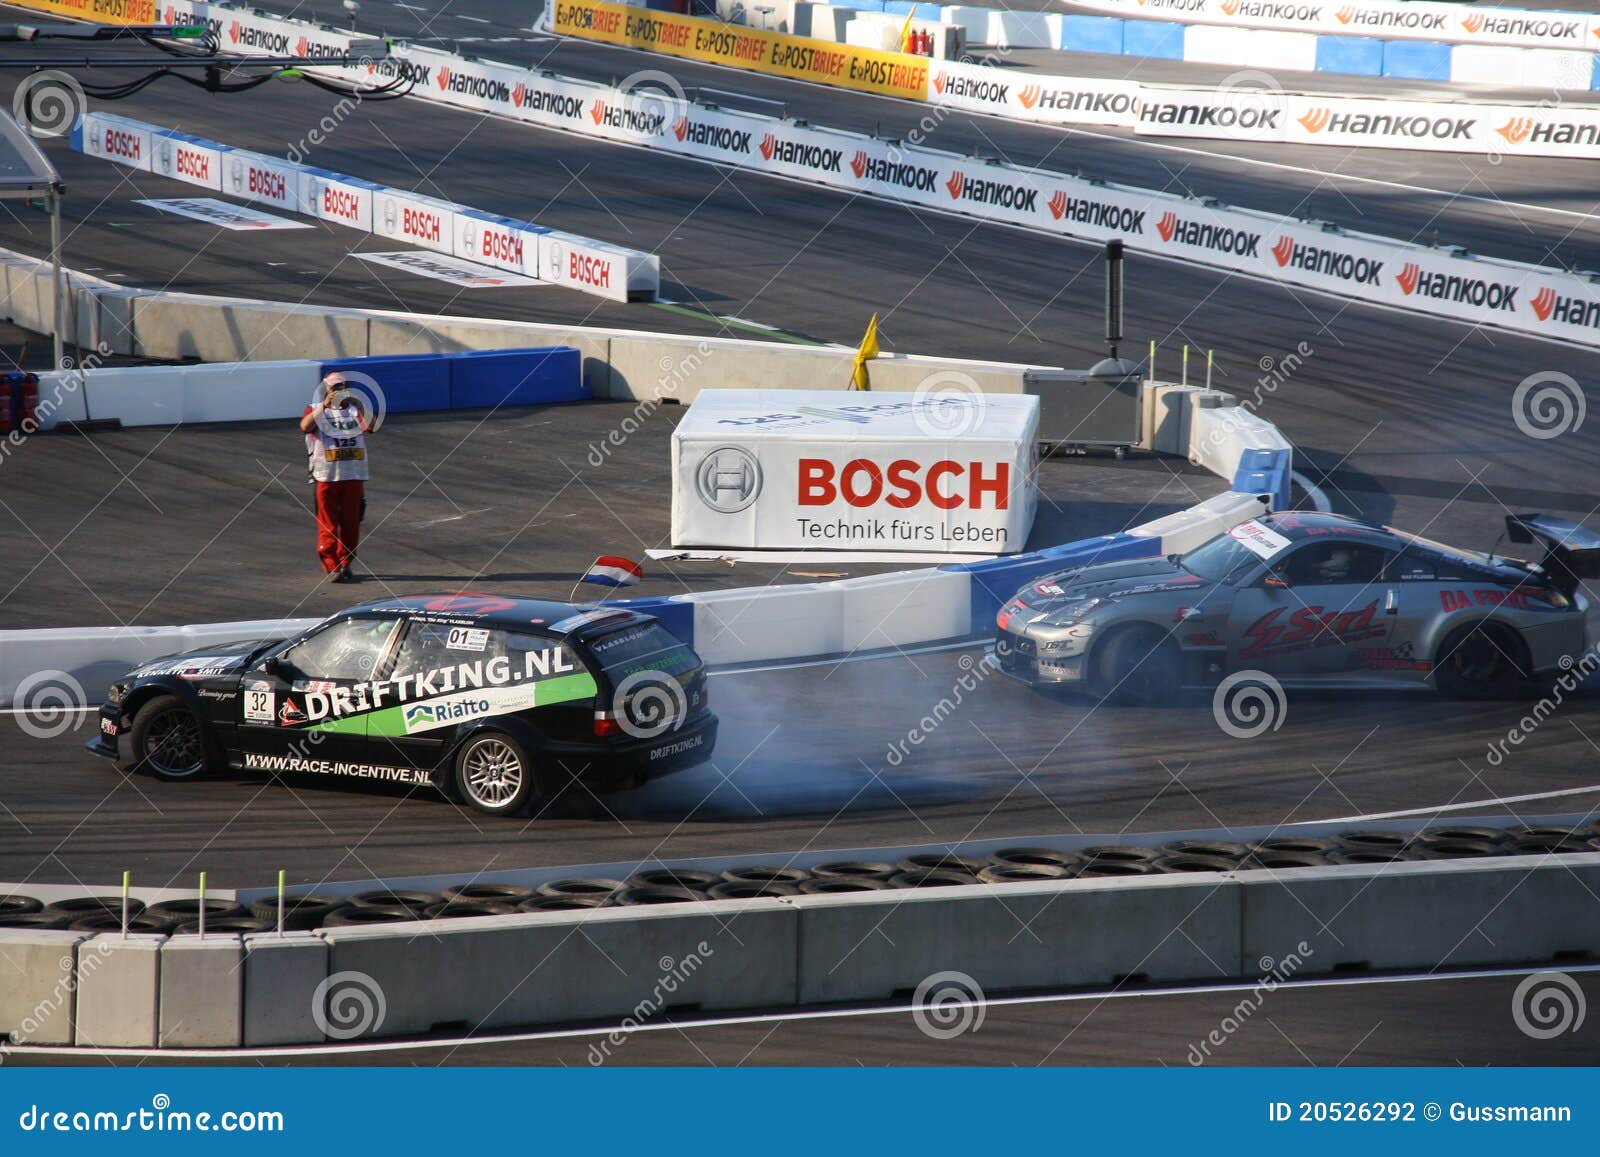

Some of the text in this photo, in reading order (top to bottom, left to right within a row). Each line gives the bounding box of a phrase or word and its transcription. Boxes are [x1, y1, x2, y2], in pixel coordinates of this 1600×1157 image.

[105, 129, 141, 161] BOSCH
[176, 148, 209, 180] BOSCH
[249, 167, 285, 200] BOSCH
[324, 187, 359, 221] BOSCH
[403, 207, 440, 242] BOSCH
[482, 230, 524, 265] BOSCH
[570, 252, 610, 288] BOSCH
[797, 458, 1009, 510] BOSCH
[797, 517, 1008, 543] Technik fürs Leben
[449, 629, 469, 644] 01
[197, 668, 224, 676] SMIT
[305, 647, 574, 721] DRIFTKING.NL
[251, 692, 267, 712] 32
[435, 698, 490, 722] Rialto
[245, 753, 433, 785] WWW.RACE-INCENTIVE.NL
